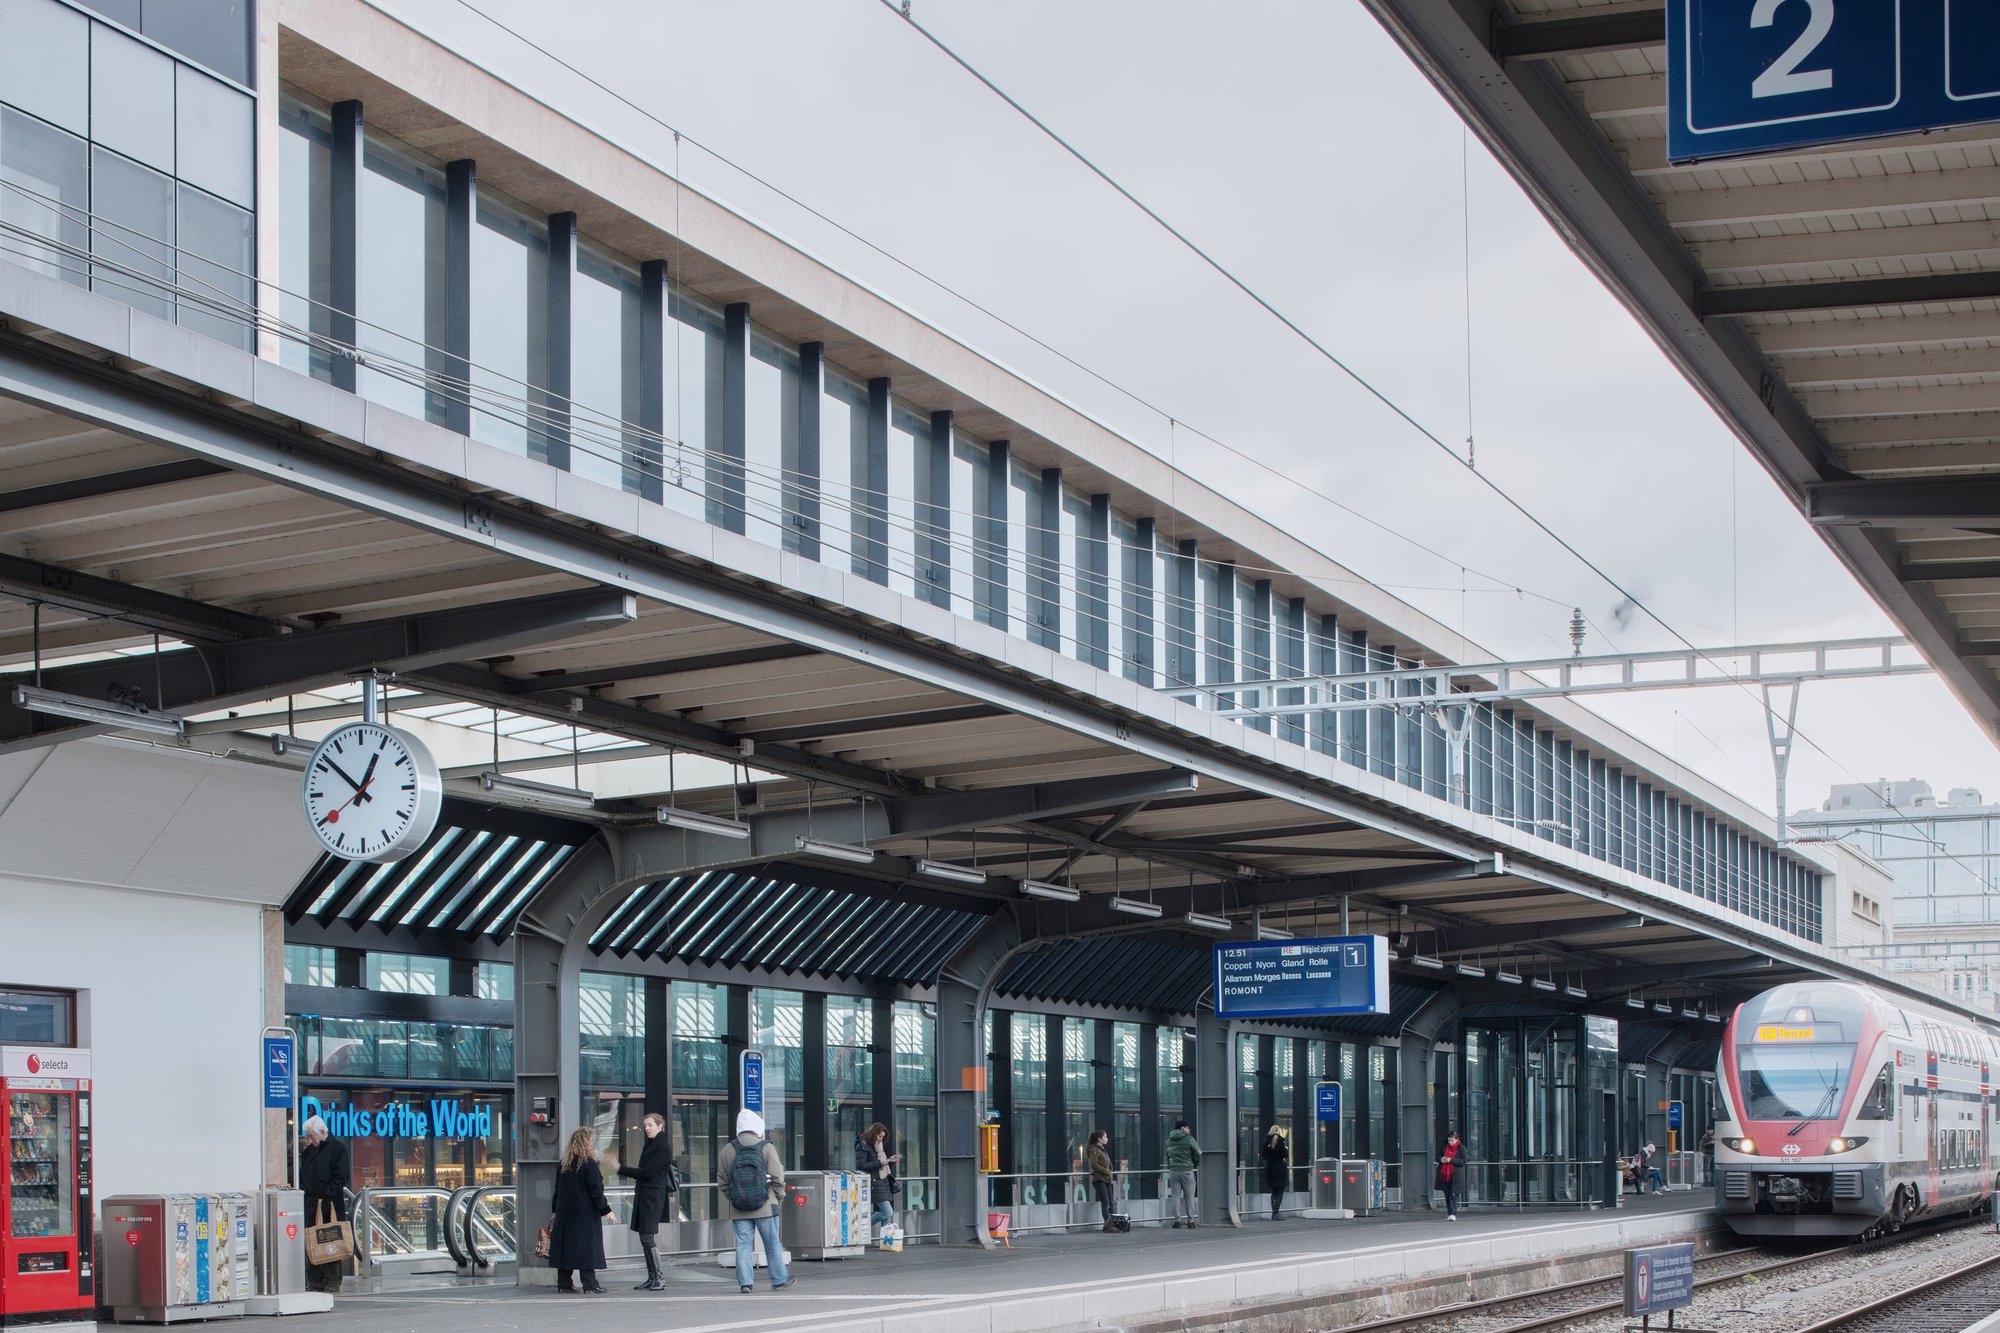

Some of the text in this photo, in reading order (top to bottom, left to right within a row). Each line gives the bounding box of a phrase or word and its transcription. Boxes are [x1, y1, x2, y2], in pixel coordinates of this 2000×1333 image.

[1750, 0, 1834, 98] 2
[1302, 945, 1339, 954] RegioExpress
[1351, 951, 1358, 964] 1
[1224, 958, 1328, 970] Coppet Nyon Gland Rolle
[1254, 974, 1281, 982] Morges
[1306, 971, 1332, 979] Lausanne
[1224, 986, 1264, 995] ROMONT
[1779, 1028, 1813, 1039] Romont
[41, 1060, 68, 1070] selecta
[302, 1096, 491, 1137] Drinks of the World
